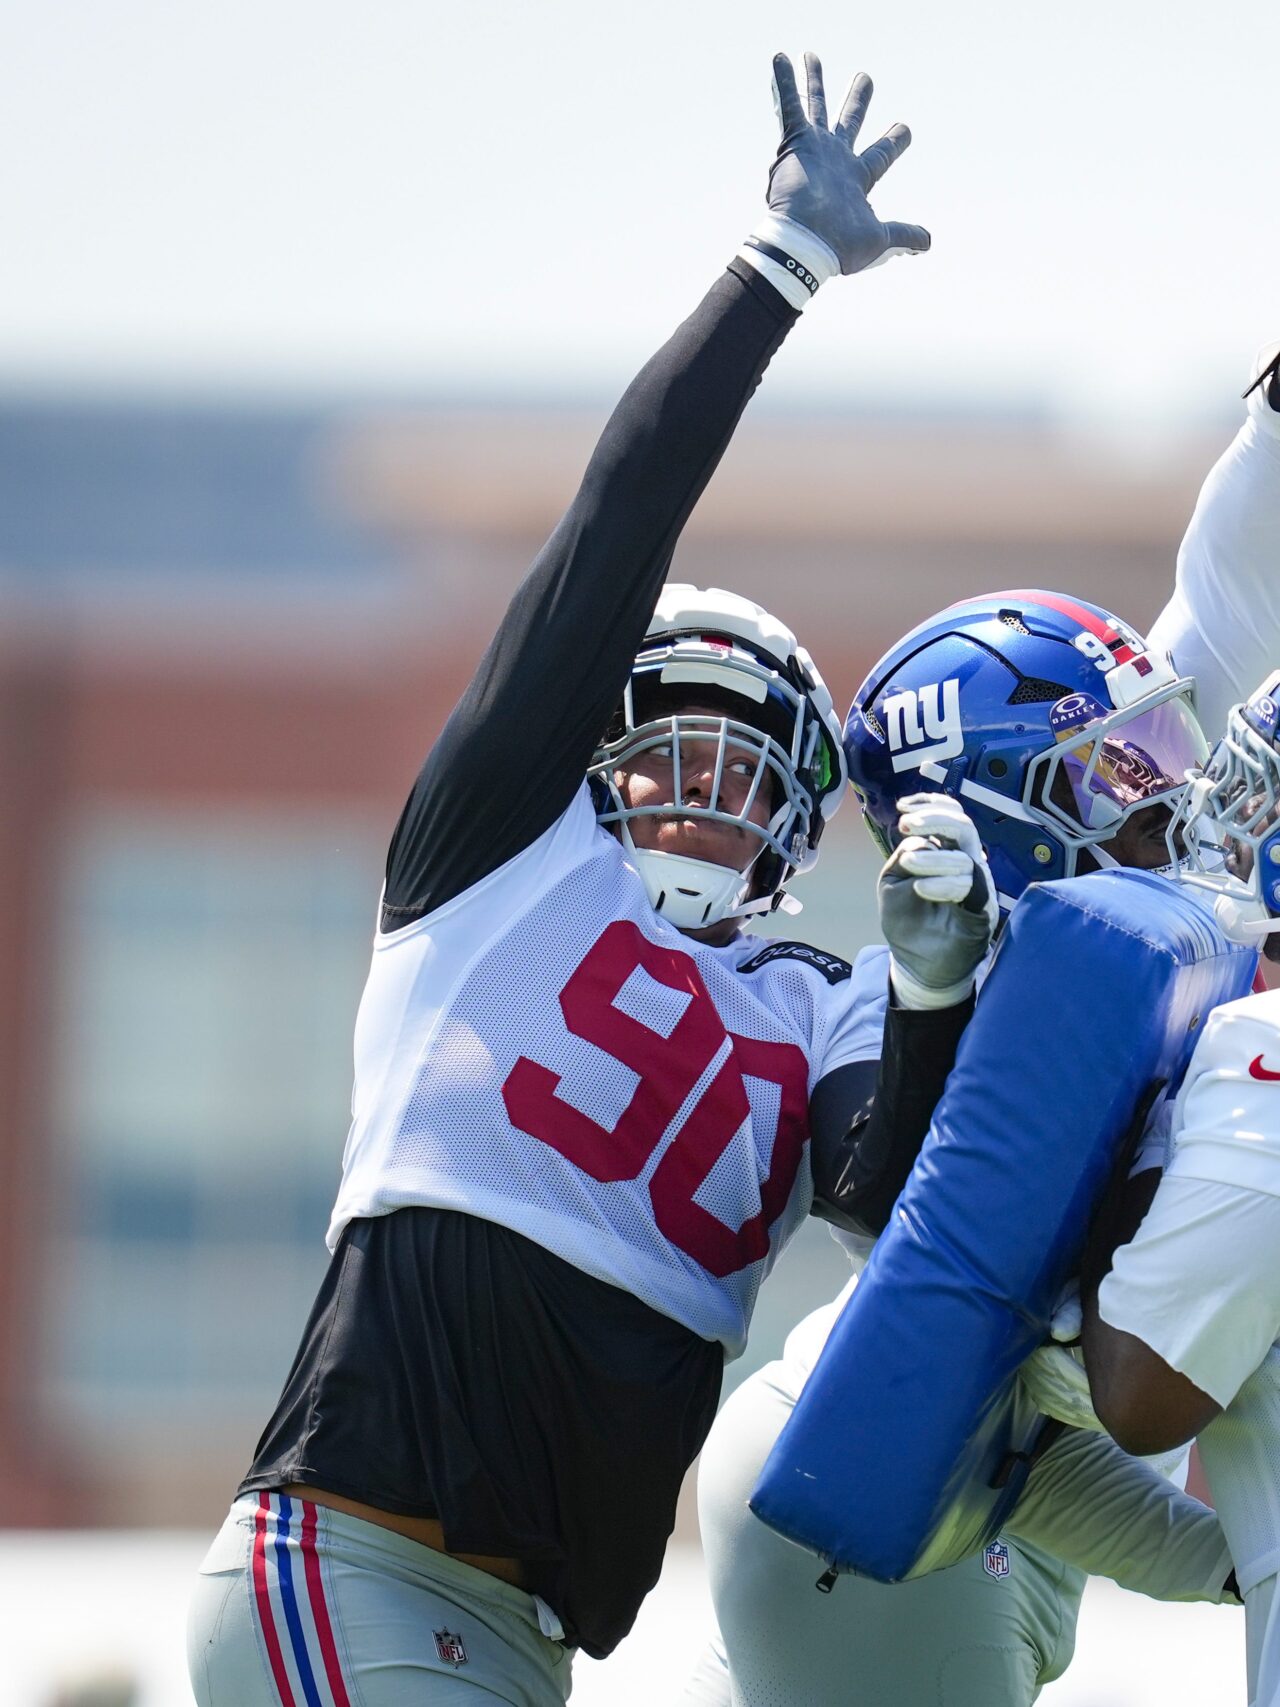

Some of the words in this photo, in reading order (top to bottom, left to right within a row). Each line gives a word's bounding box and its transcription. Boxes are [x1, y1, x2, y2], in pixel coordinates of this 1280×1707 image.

[1052, 702, 1097, 725] OAKLEY
[751, 946, 843, 973] Quest
[501, 919, 812, 1278] 90
[988, 1554, 1008, 1573] NFL
[439, 1644, 465, 1661] NFL
